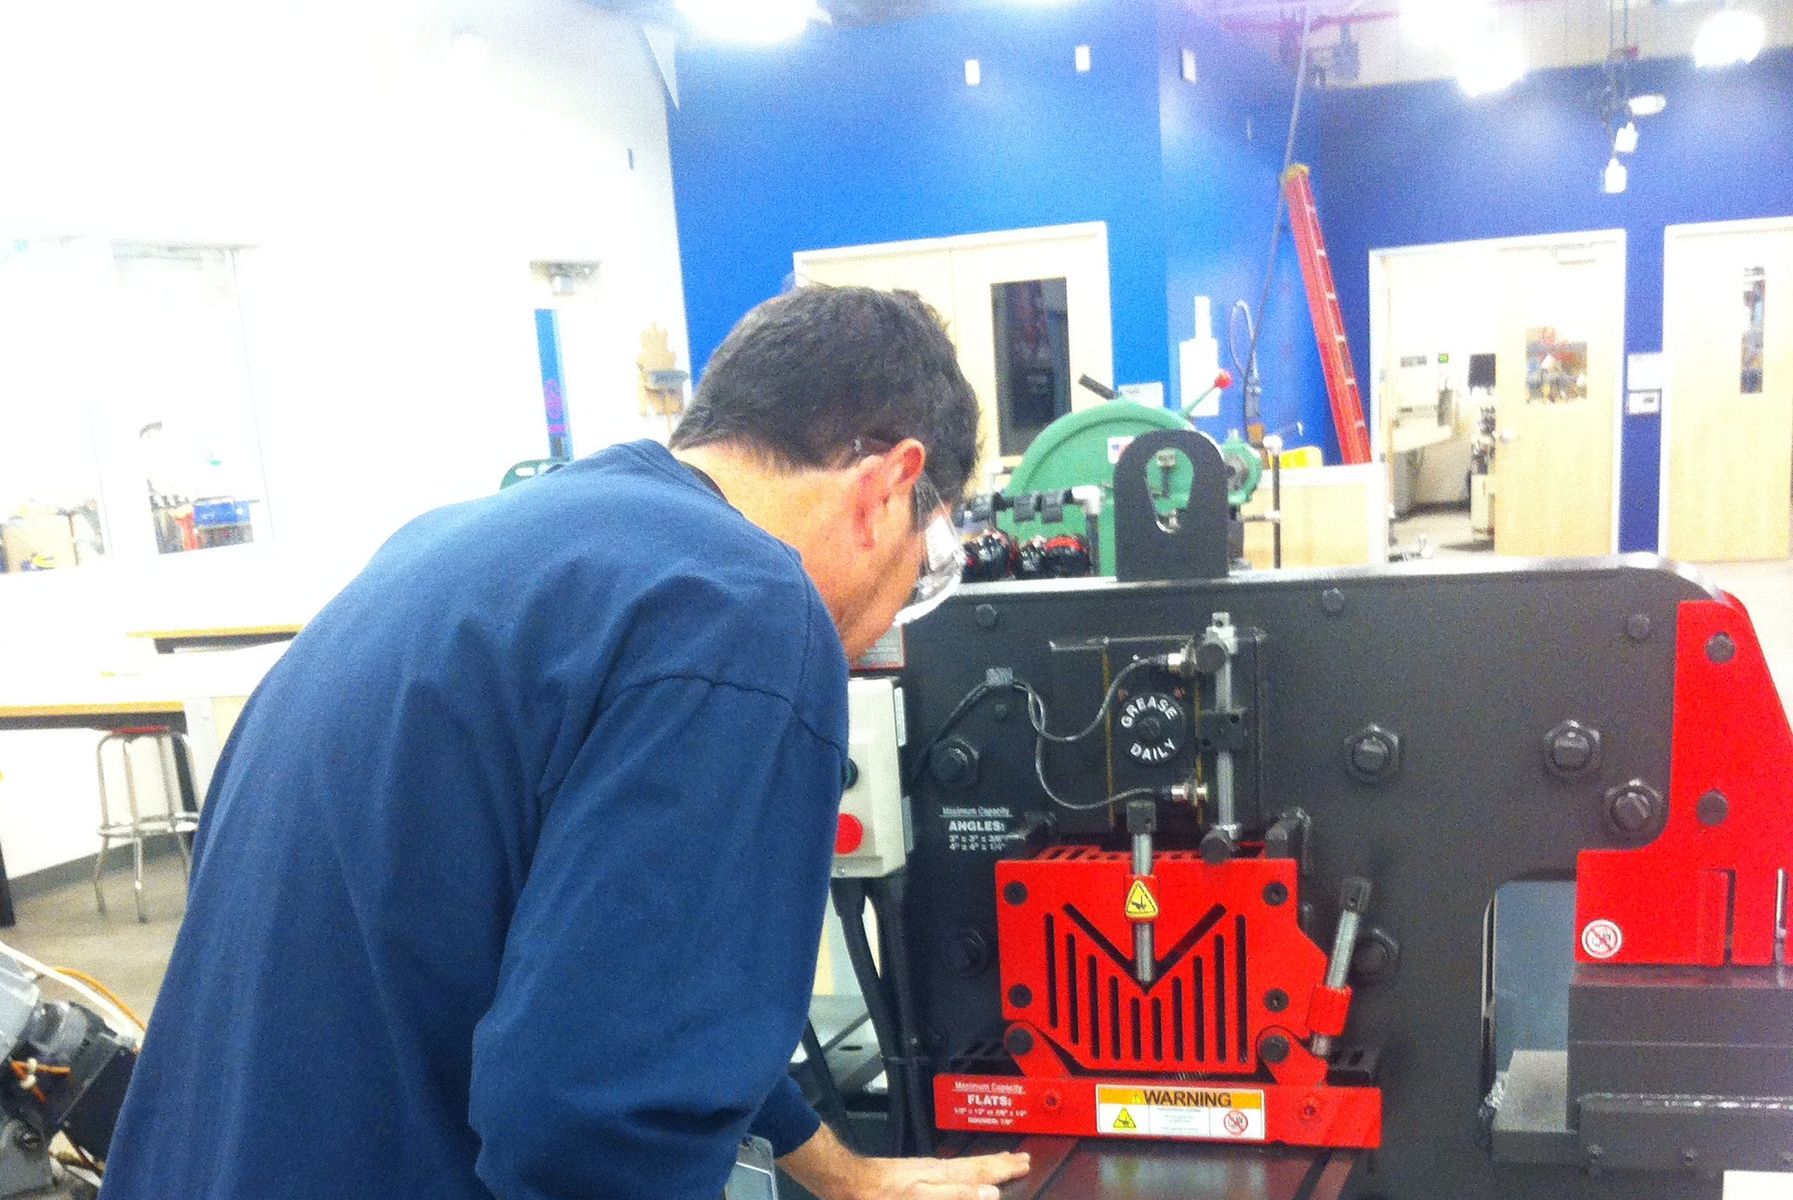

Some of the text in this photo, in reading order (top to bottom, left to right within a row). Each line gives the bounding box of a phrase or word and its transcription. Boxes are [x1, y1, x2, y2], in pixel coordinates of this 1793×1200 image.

[1121, 695, 1178, 728] GREASE
[1130, 738, 1176, 760] DAILY
[949, 820, 1005, 832] ANGLES:
[954, 1081, 1024, 1095] Maximum Capacity
[967, 1094, 1012, 1107] FLATS:
[1143, 1090, 1232, 1108] WARNING
